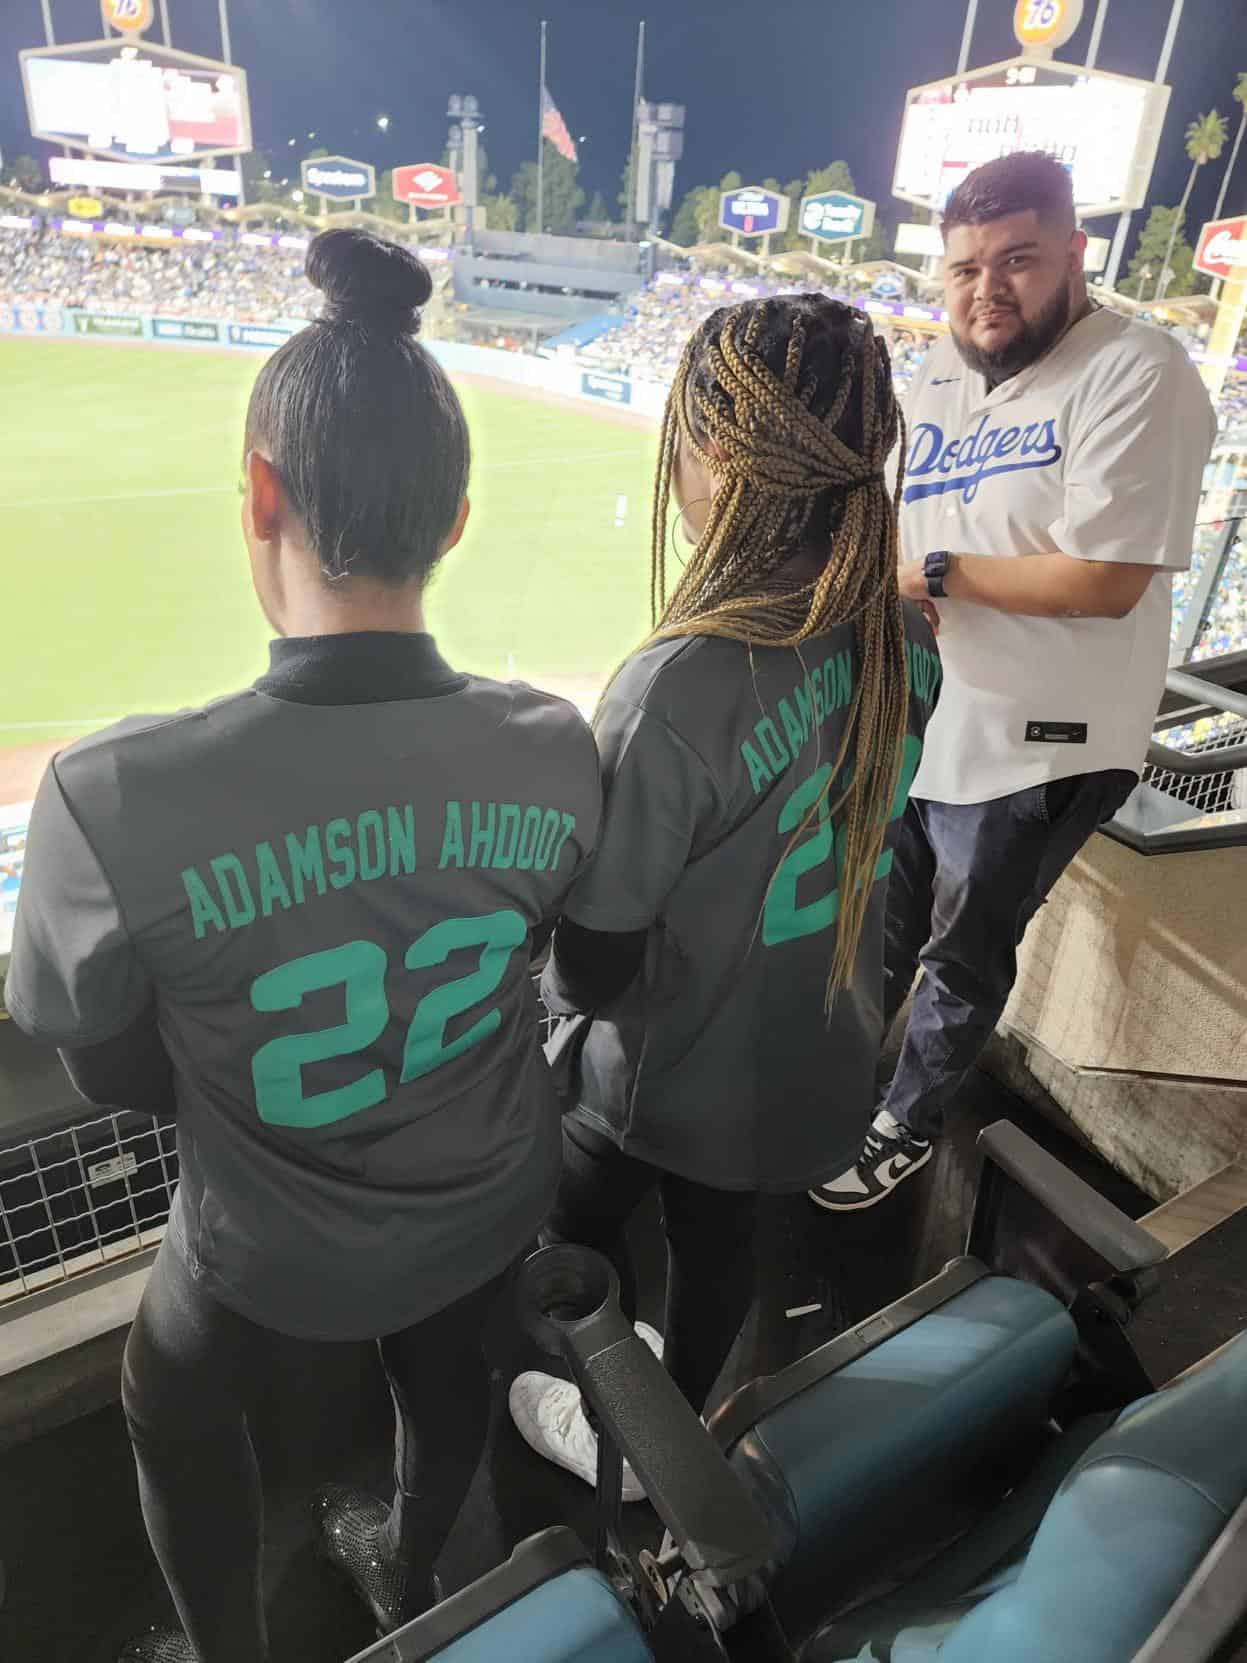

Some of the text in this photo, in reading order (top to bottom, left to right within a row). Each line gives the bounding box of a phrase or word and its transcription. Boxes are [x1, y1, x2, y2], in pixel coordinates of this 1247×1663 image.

[905, 414, 1057, 504] Dodgers
[741, 648, 852, 795] ADAMSON
[182, 801, 576, 939] ADAMSON AHDOOT
[250, 910, 528, 1129] 22
